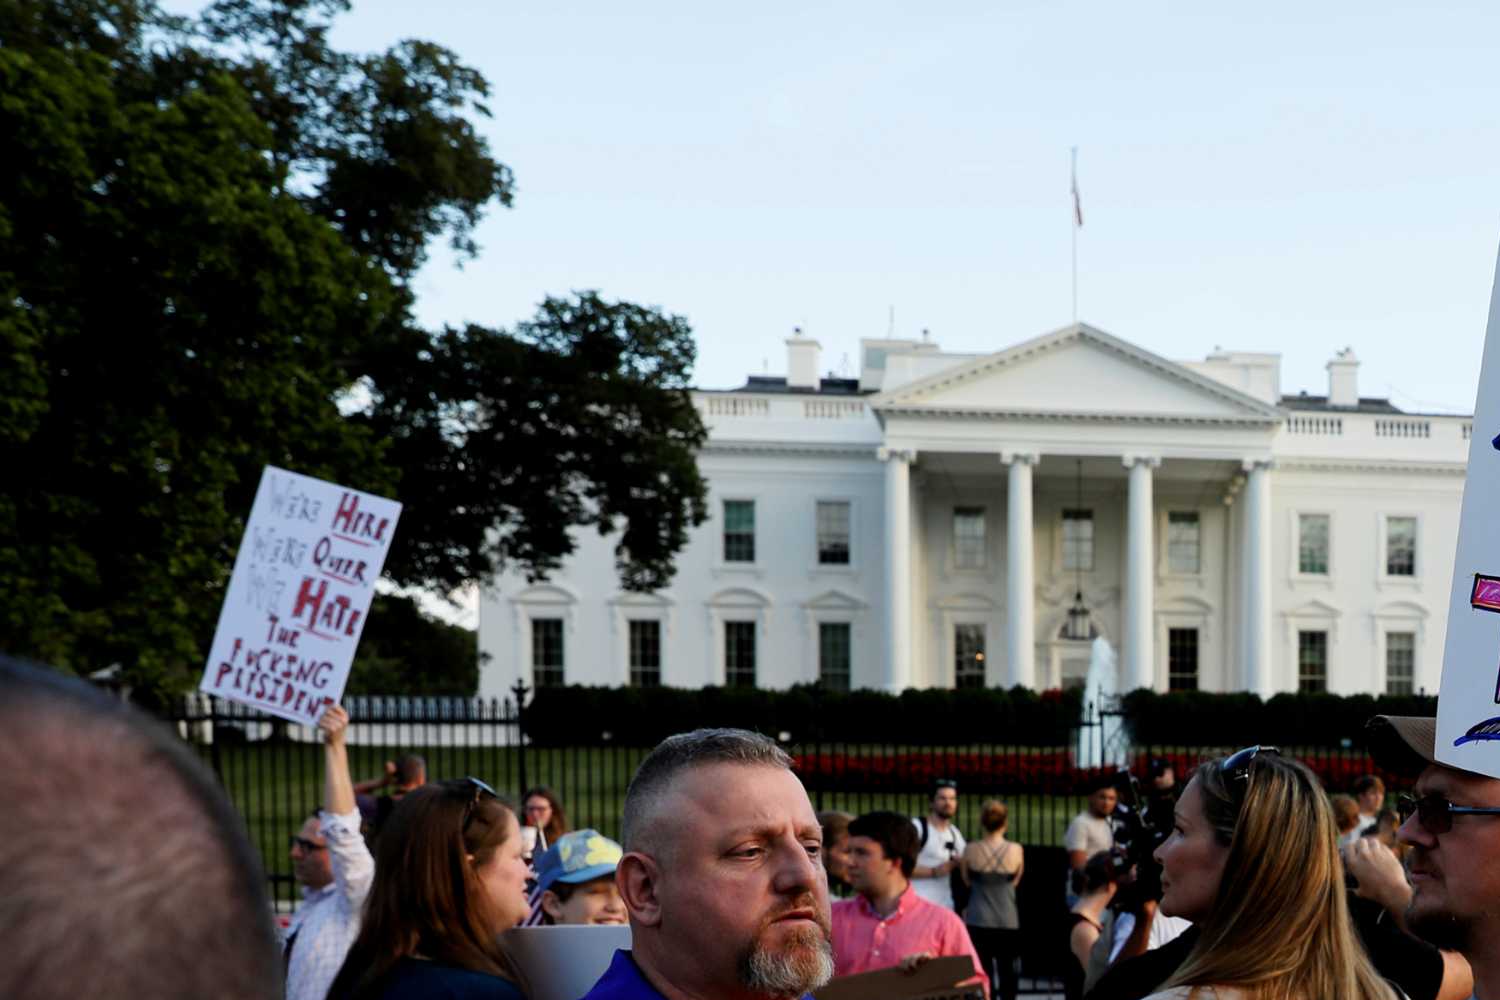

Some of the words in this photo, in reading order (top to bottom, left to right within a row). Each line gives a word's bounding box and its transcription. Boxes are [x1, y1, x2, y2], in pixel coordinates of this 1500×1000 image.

[266, 613, 300, 648] THE
[292, 575, 362, 637] HATE
[230, 638, 334, 689] FUCKING
